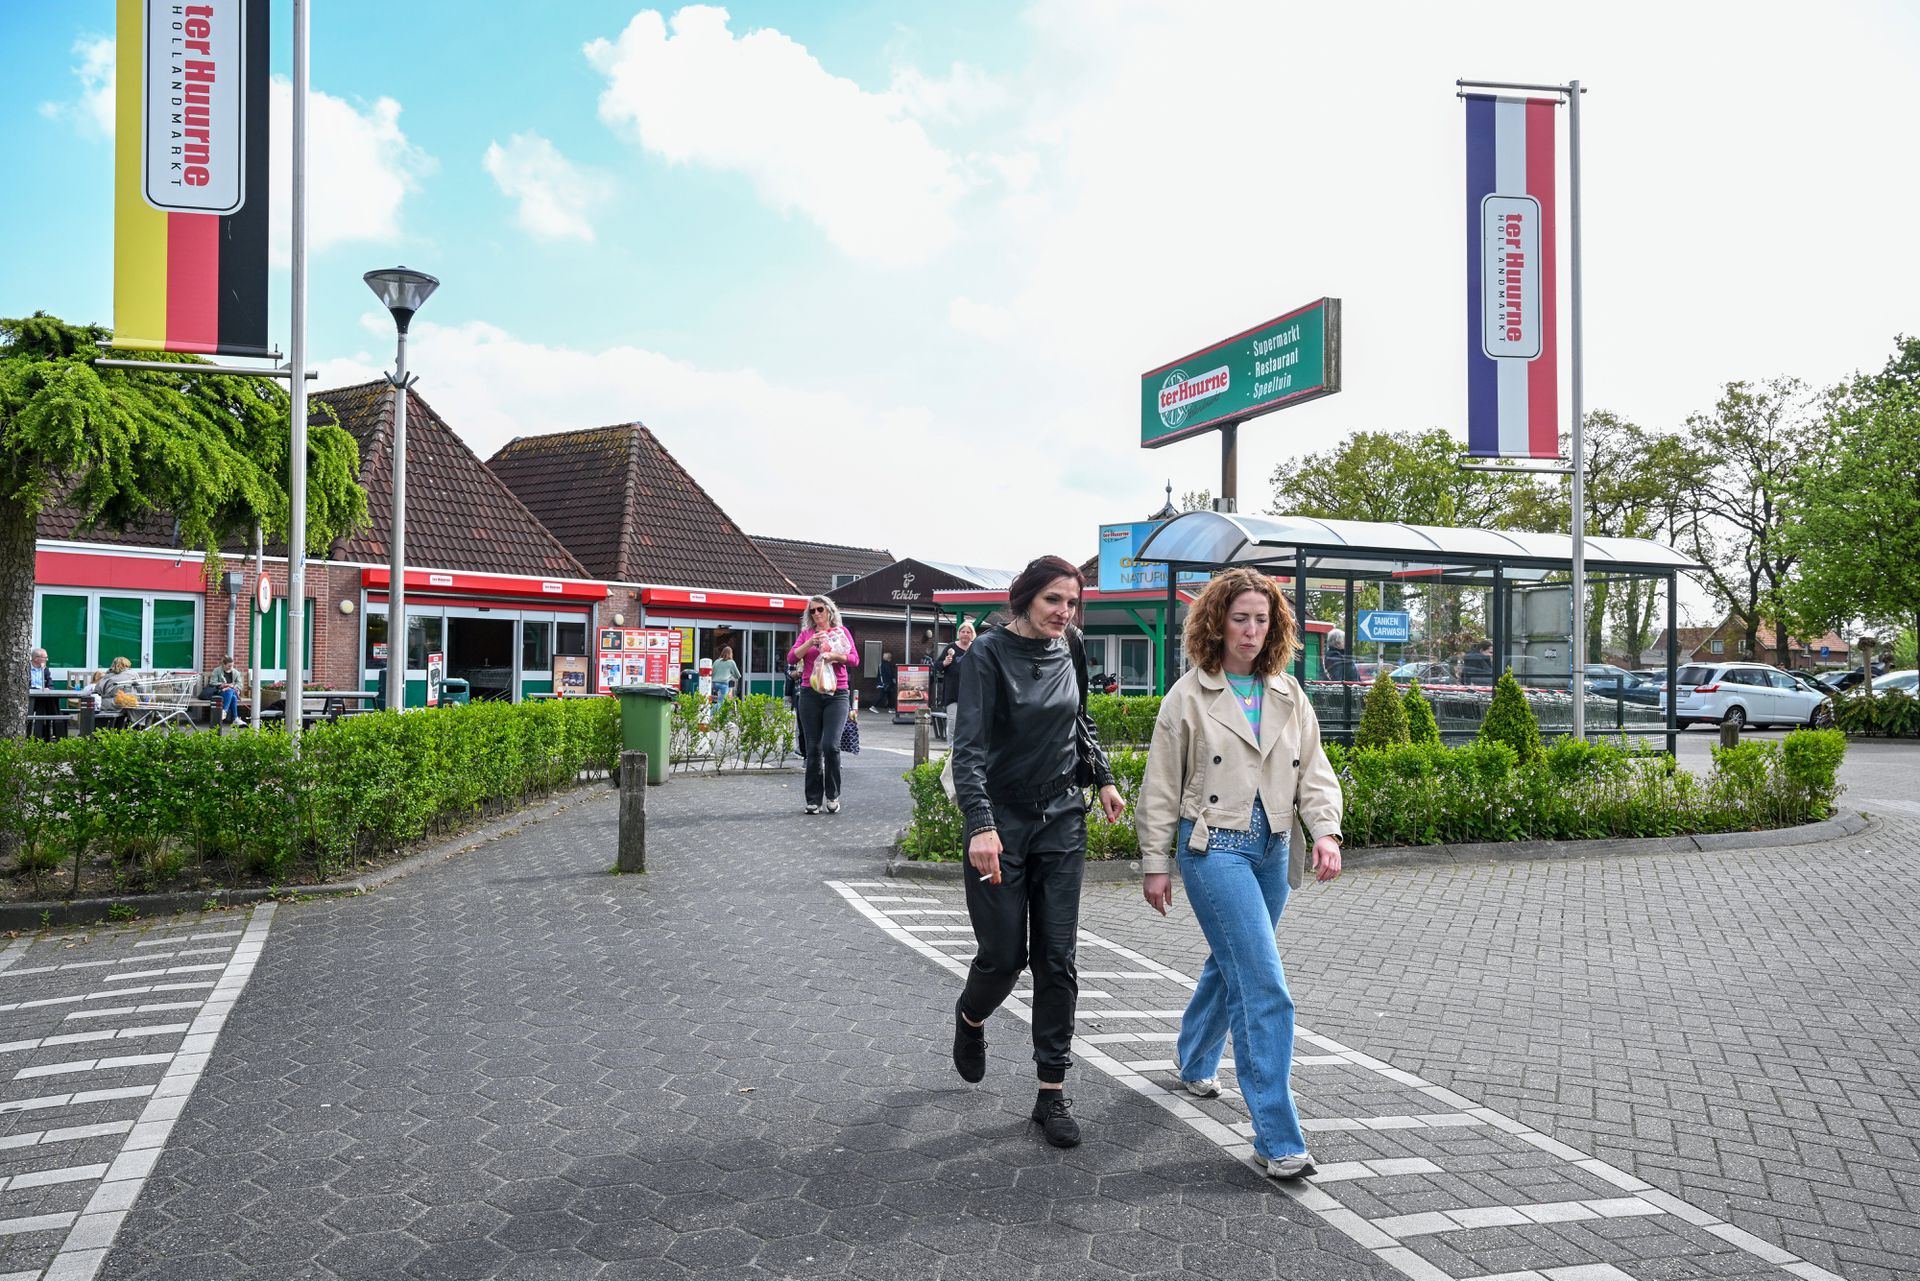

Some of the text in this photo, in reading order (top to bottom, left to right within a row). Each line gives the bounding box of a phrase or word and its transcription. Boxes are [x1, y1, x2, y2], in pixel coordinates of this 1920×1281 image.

[171, 6, 183, 187] HOLLANDMARKT
[1498, 214, 1506, 343] HOLLANDMARKT
[1253, 324, 1300, 356] Supermarkt
[1255, 347, 1299, 378] Restaurant
[1253, 372, 1292, 399] Speeltuin
[891, 590, 921, 600] Tchibo
[1373, 617, 1399, 625] TANKEN
[1373, 627, 1405, 636] CARWASH
